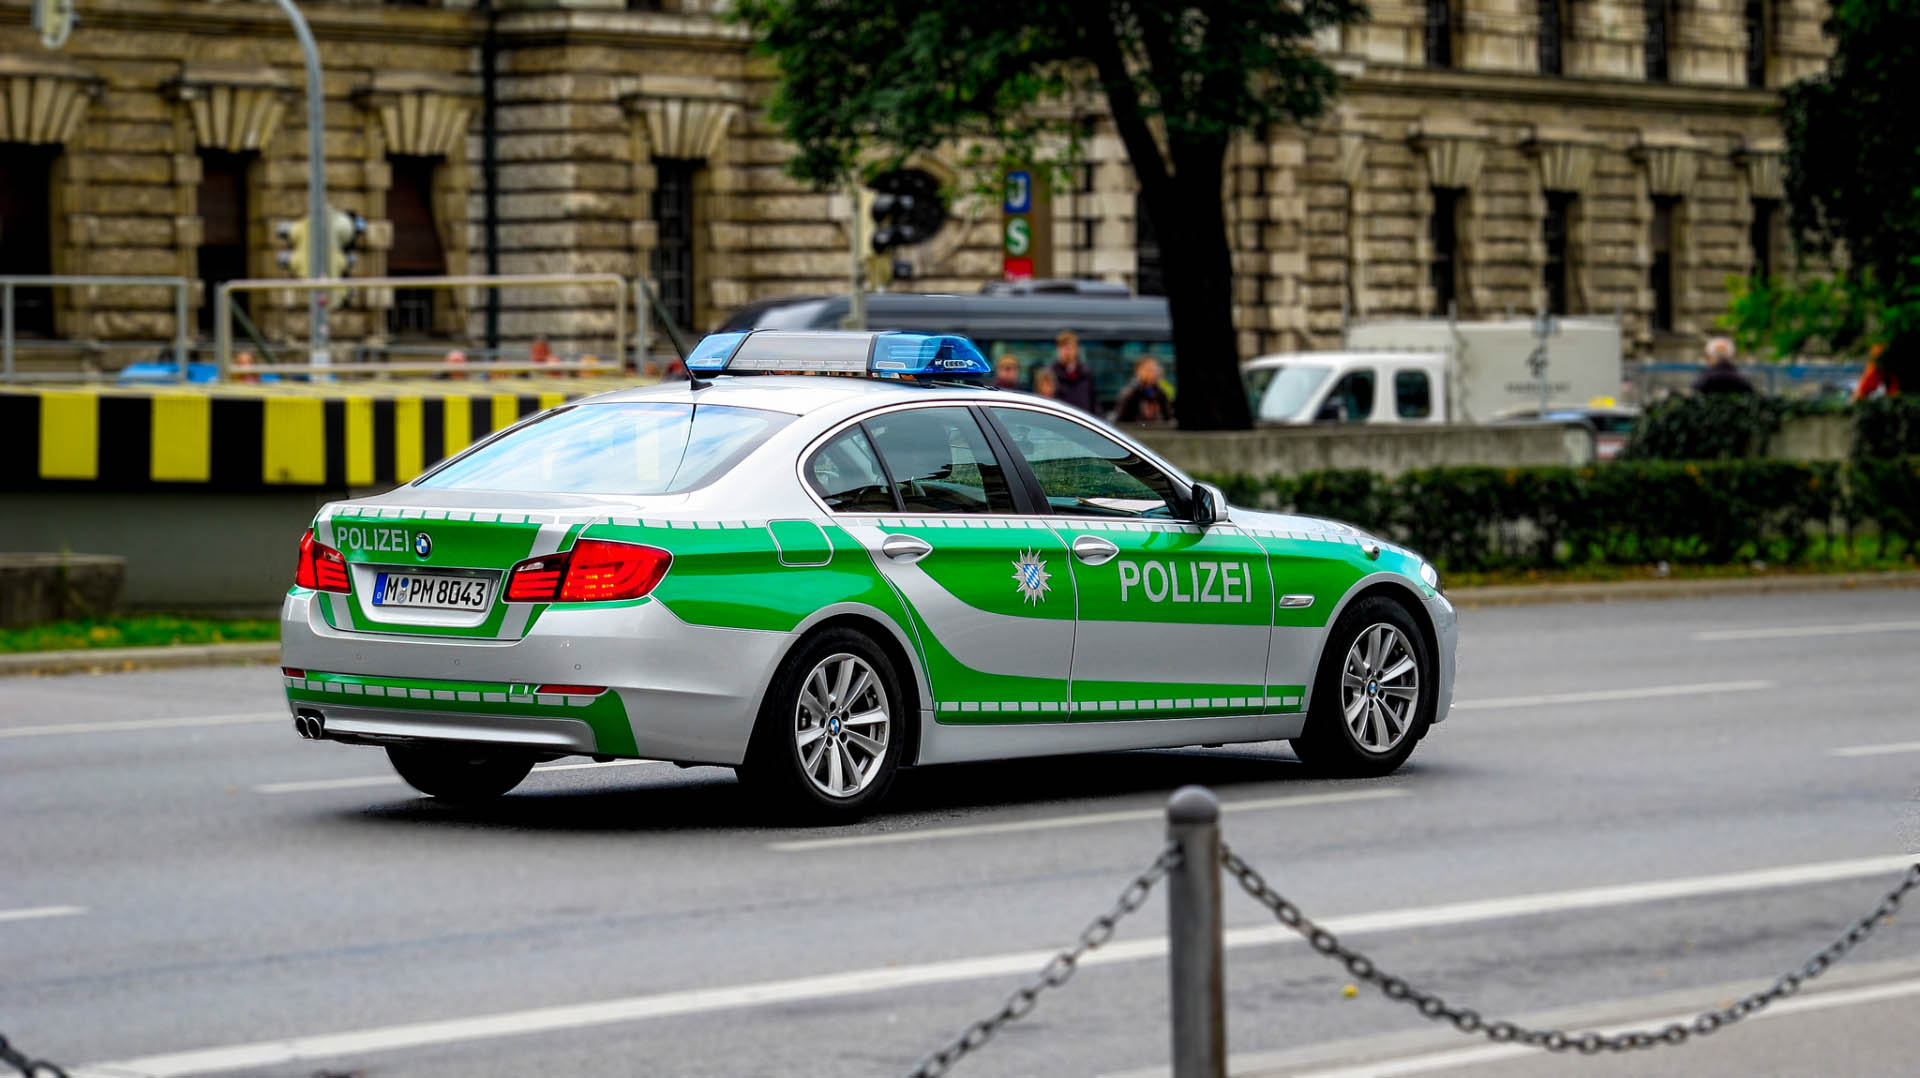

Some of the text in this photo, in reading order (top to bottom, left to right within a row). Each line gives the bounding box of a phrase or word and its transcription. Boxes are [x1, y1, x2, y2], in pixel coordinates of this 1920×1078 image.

[1007, 218, 1029, 255] S
[337, 526, 410, 552] POLIZEI
[385, 577, 486, 606] M PM 8043
[1118, 560, 1252, 602] POLIZEI
